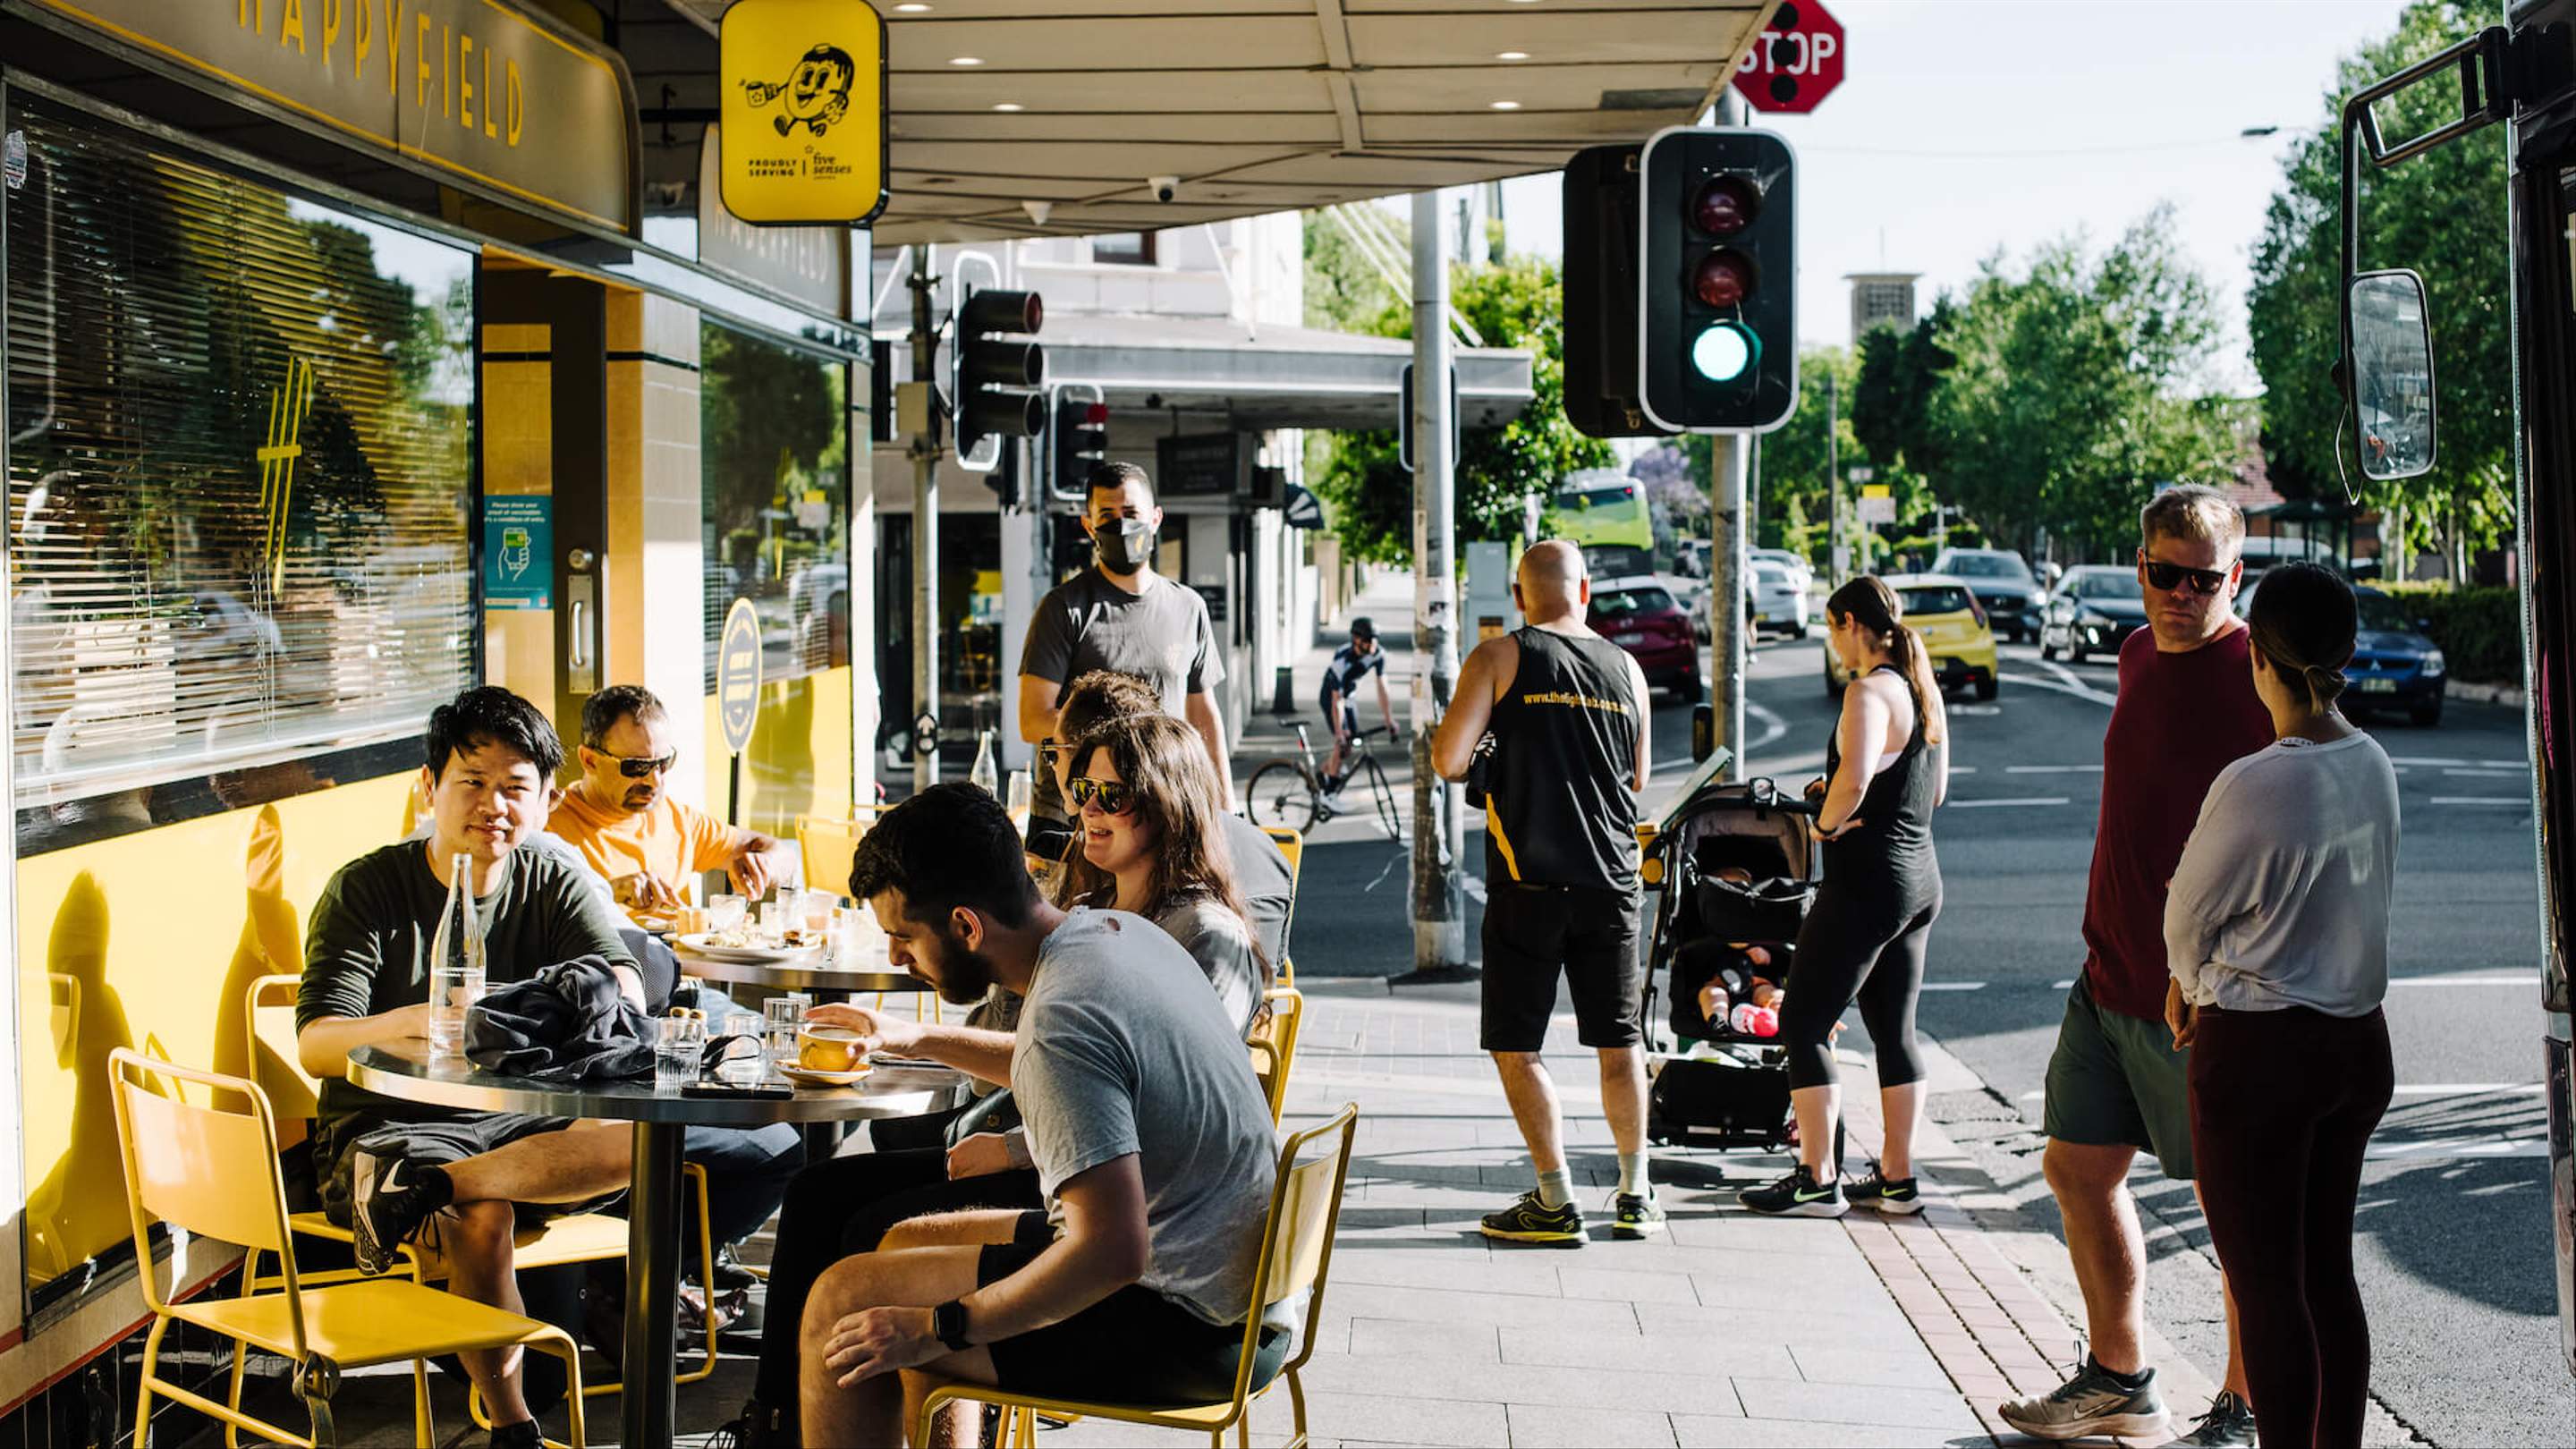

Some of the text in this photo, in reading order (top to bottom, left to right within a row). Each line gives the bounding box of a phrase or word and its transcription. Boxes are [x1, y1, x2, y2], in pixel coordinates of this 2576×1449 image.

[813, 151, 836, 165] five
[749, 159, 797, 167] PROUDLY
[749, 168, 795, 177] SERVING
[813, 165, 852, 174] senses
